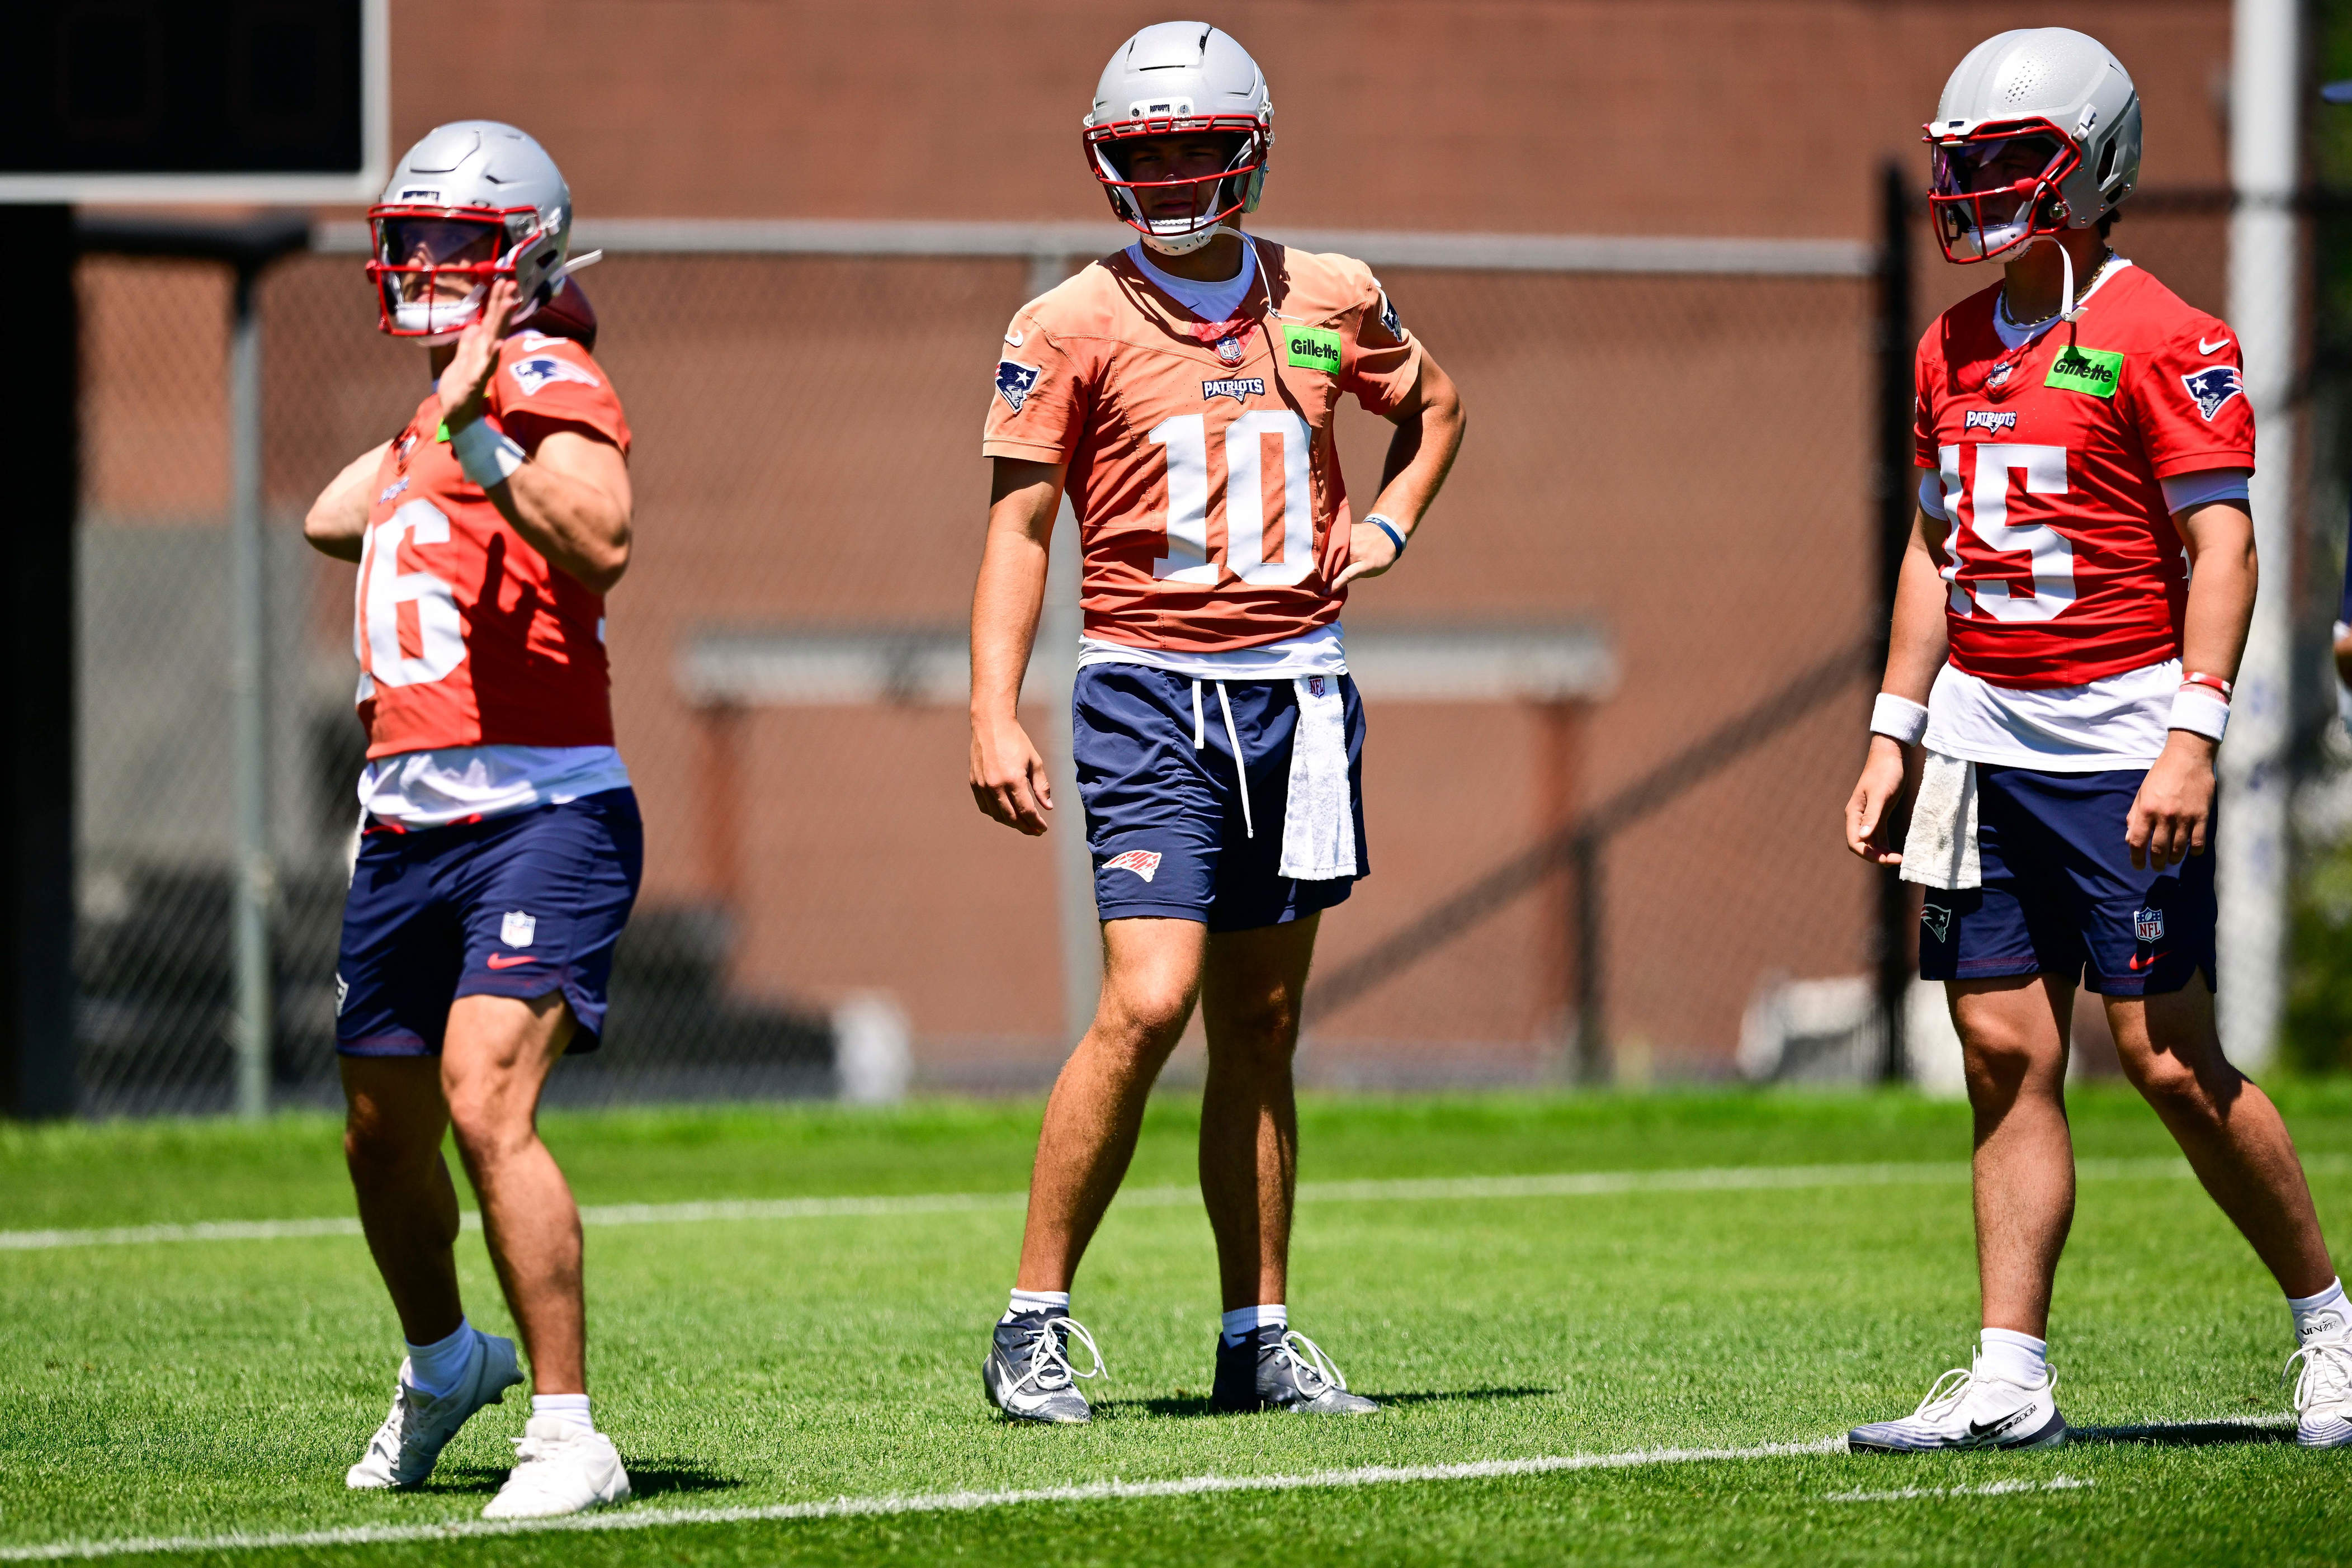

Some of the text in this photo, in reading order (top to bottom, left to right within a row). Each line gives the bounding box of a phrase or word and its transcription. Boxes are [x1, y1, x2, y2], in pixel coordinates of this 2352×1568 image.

[1291, 338, 1339, 362] Gillette
[2053, 358, 2113, 383] Gillette
[1203, 379, 1264, 397] PATRIOTS
[1966, 410, 2016, 427] PATRIOTS
[1147, 410, 1315, 585] 10
[1309, 678, 1324, 696] NFL
[2138, 922, 2161, 938] NFL
[2013, 1404, 2037, 1425] ZOOM
